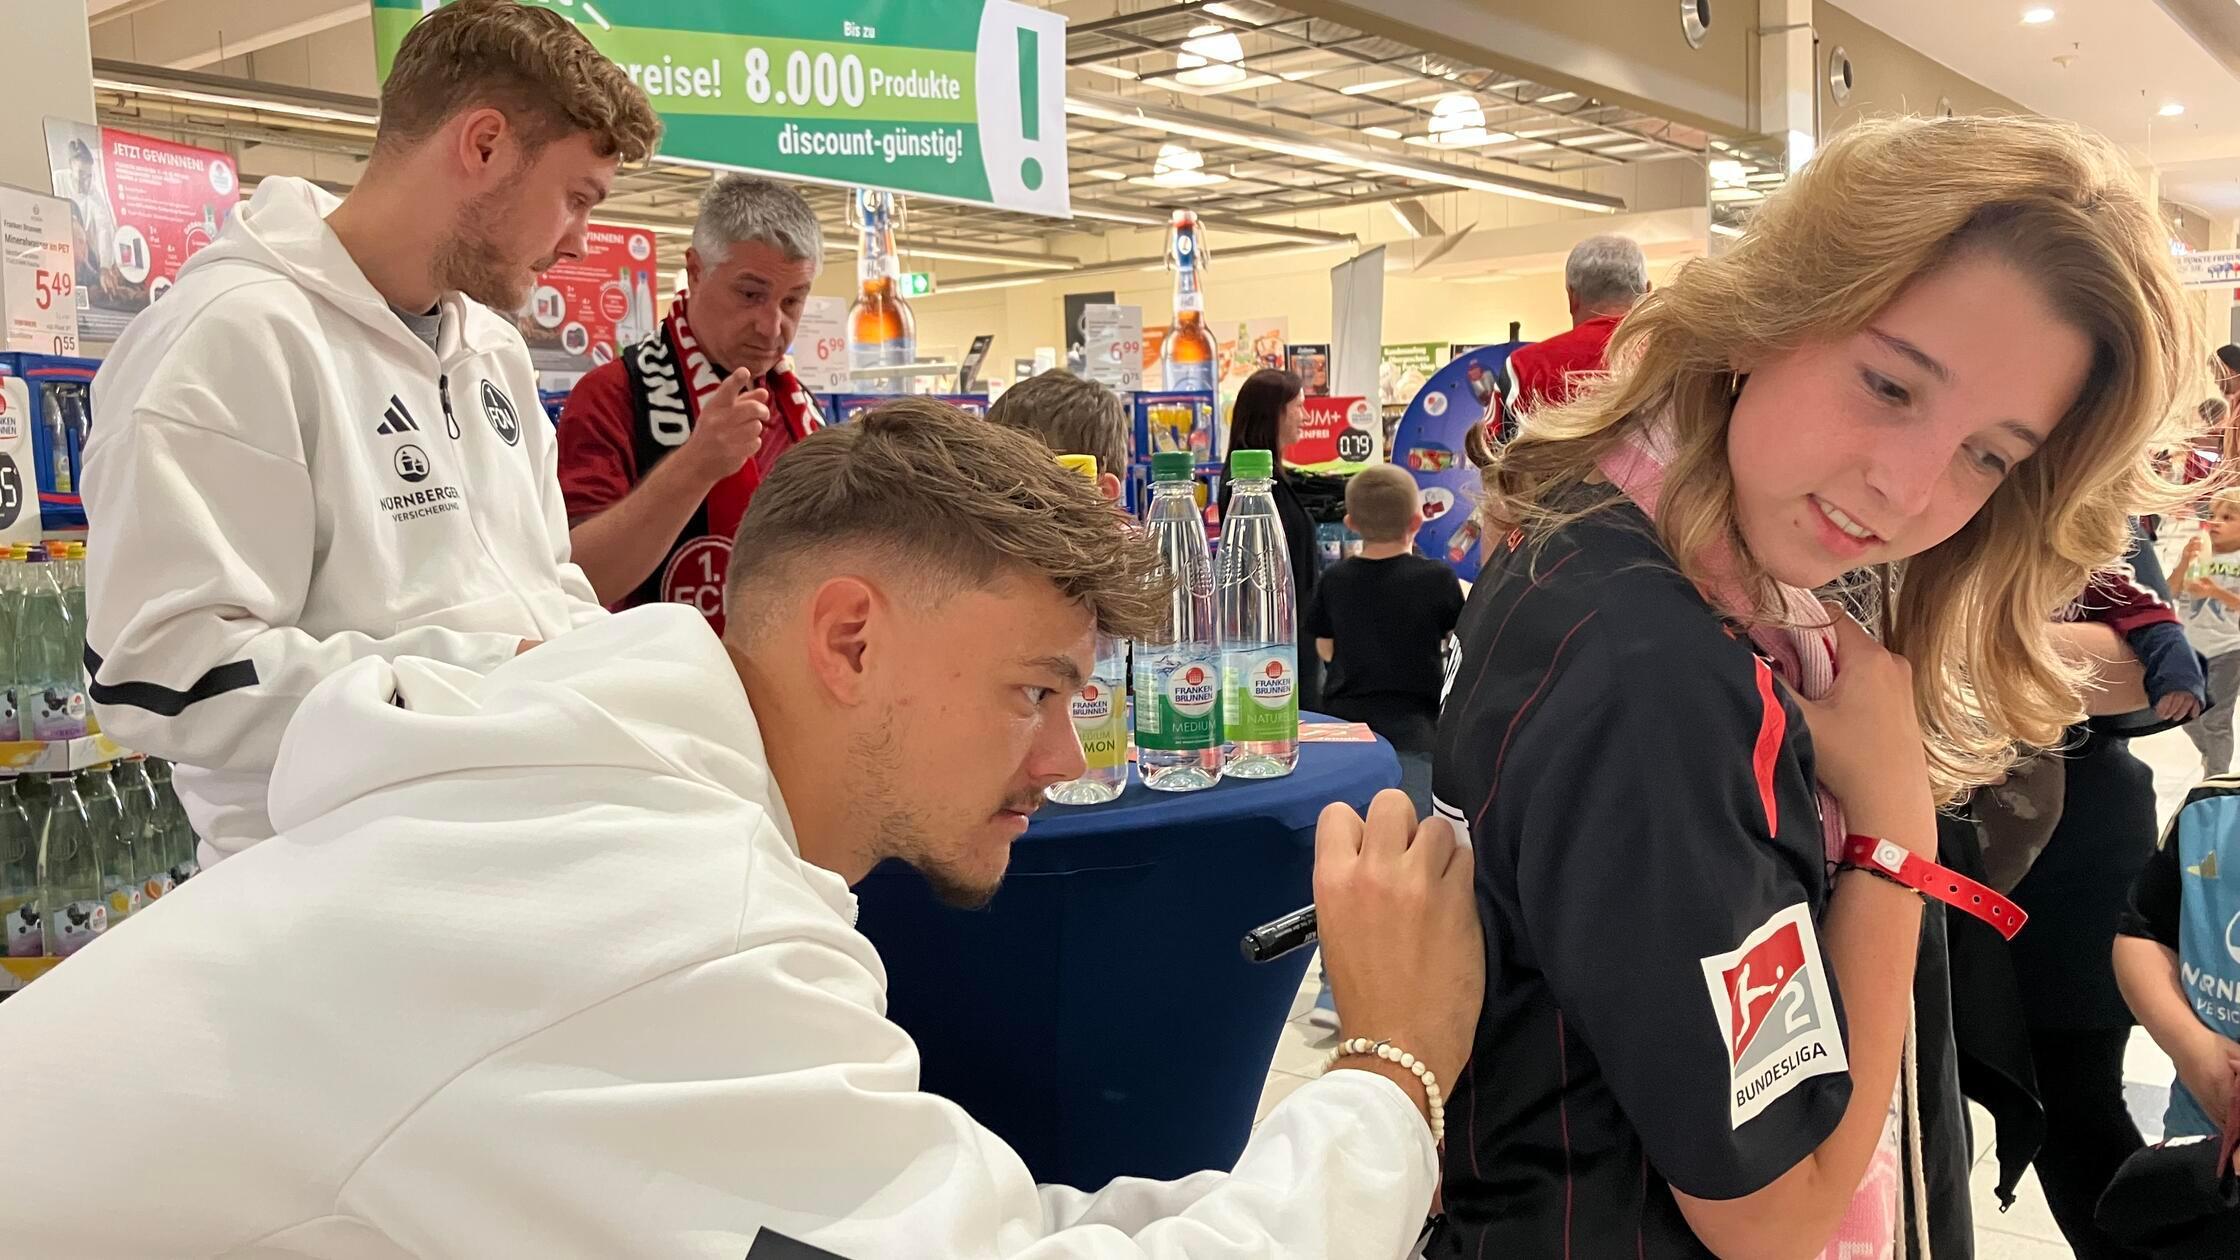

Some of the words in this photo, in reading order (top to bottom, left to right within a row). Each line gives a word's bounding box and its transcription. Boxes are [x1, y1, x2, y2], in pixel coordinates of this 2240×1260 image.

[843, 21, 861, 37] Bis
[863, 24, 876, 38] zu
[615, 54, 722, 98] reise!
[744, 47, 864, 107] 8.000
[869, 67, 961, 100] Produkte
[777, 122, 963, 164] discount-günstig!
[113, 142, 141, 160] JETZT
[142, 148, 205, 172] GEWINNEN!
[58, 243, 70, 254] PET
[698, 550, 721, 583] 1.
[674, 584, 727, 616] FC
[1255, 678, 1291, 687] FRANKEN
[1174, 685, 1213, 695] FRANKEN
[1175, 692, 1213, 702] BRUNNEN
[1255, 685, 1291, 695] BRUNNEN
[1072, 701, 1108, 709] FRANKEN
[1072, 707, 1108, 716] BRUNNEN
[1172, 720, 1216, 733] MEDIUM
[1079, 731, 1112, 741] EDIUM
[1084, 739, 1115, 753] MON
[1780, 980, 1811, 1034] 2
[1736, 1042, 1828, 1108] BUNDESLIGA
